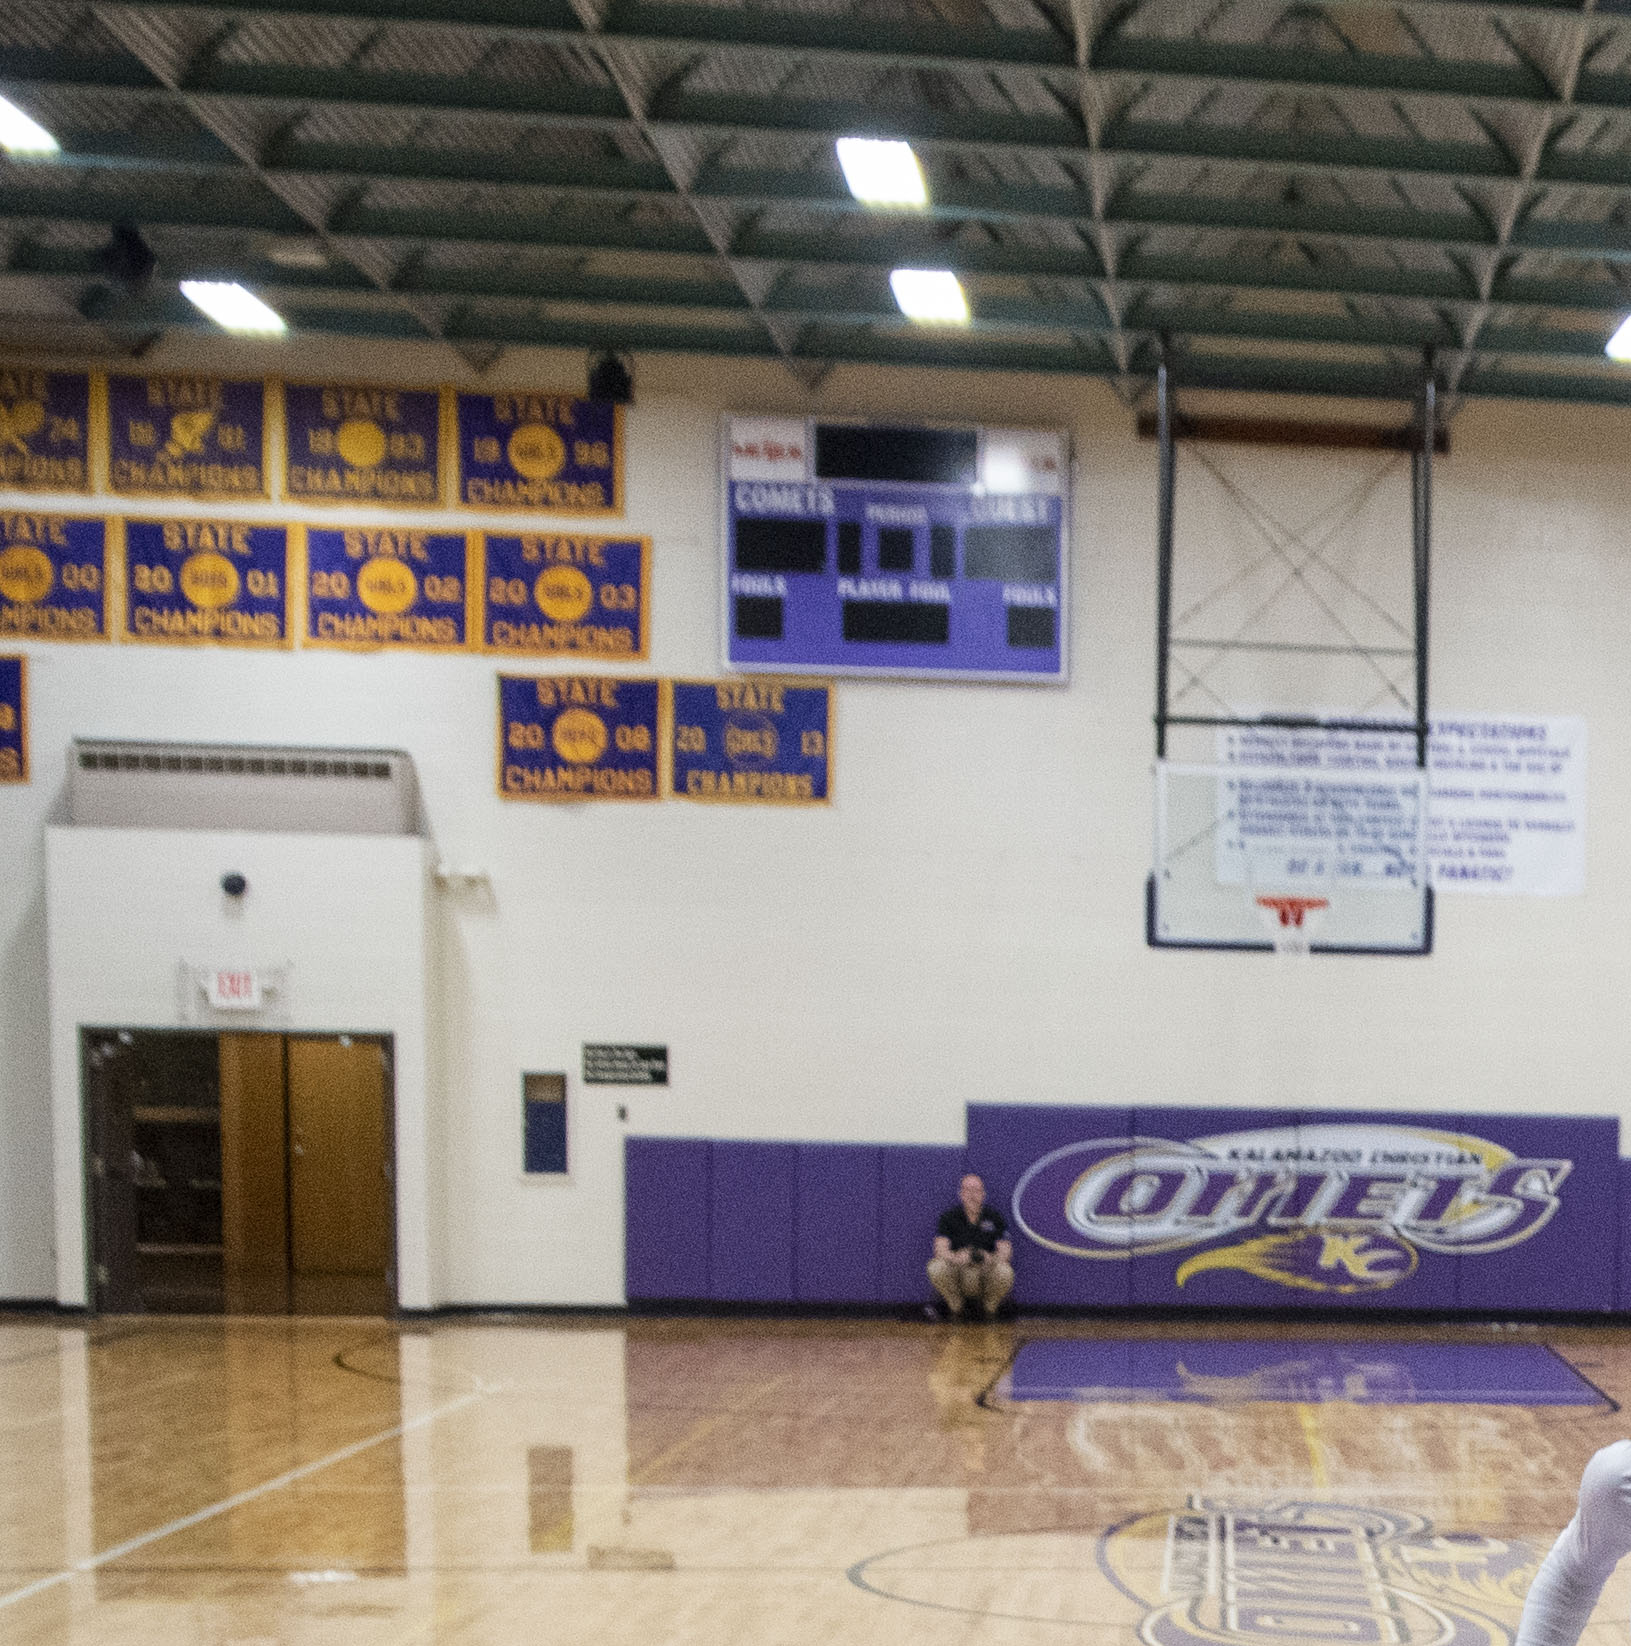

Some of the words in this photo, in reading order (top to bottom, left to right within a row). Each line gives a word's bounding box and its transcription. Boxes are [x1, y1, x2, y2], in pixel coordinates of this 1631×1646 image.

[162, 524, 252, 556] STATE
[343, 531, 430, 562] STATE
[520, 538, 607, 568] STATE
[134, 607, 281, 640] CHAMPIONS
[317, 611, 457, 646] CHAMPIONS
[492, 620, 634, 651] CHAMPIONS
[534, 679, 620, 708] STATE
[503, 766, 655, 795] CHAMPIONS
[686, 770, 814, 800] CHAMPIONS
[217, 971, 253, 999] EXIT
